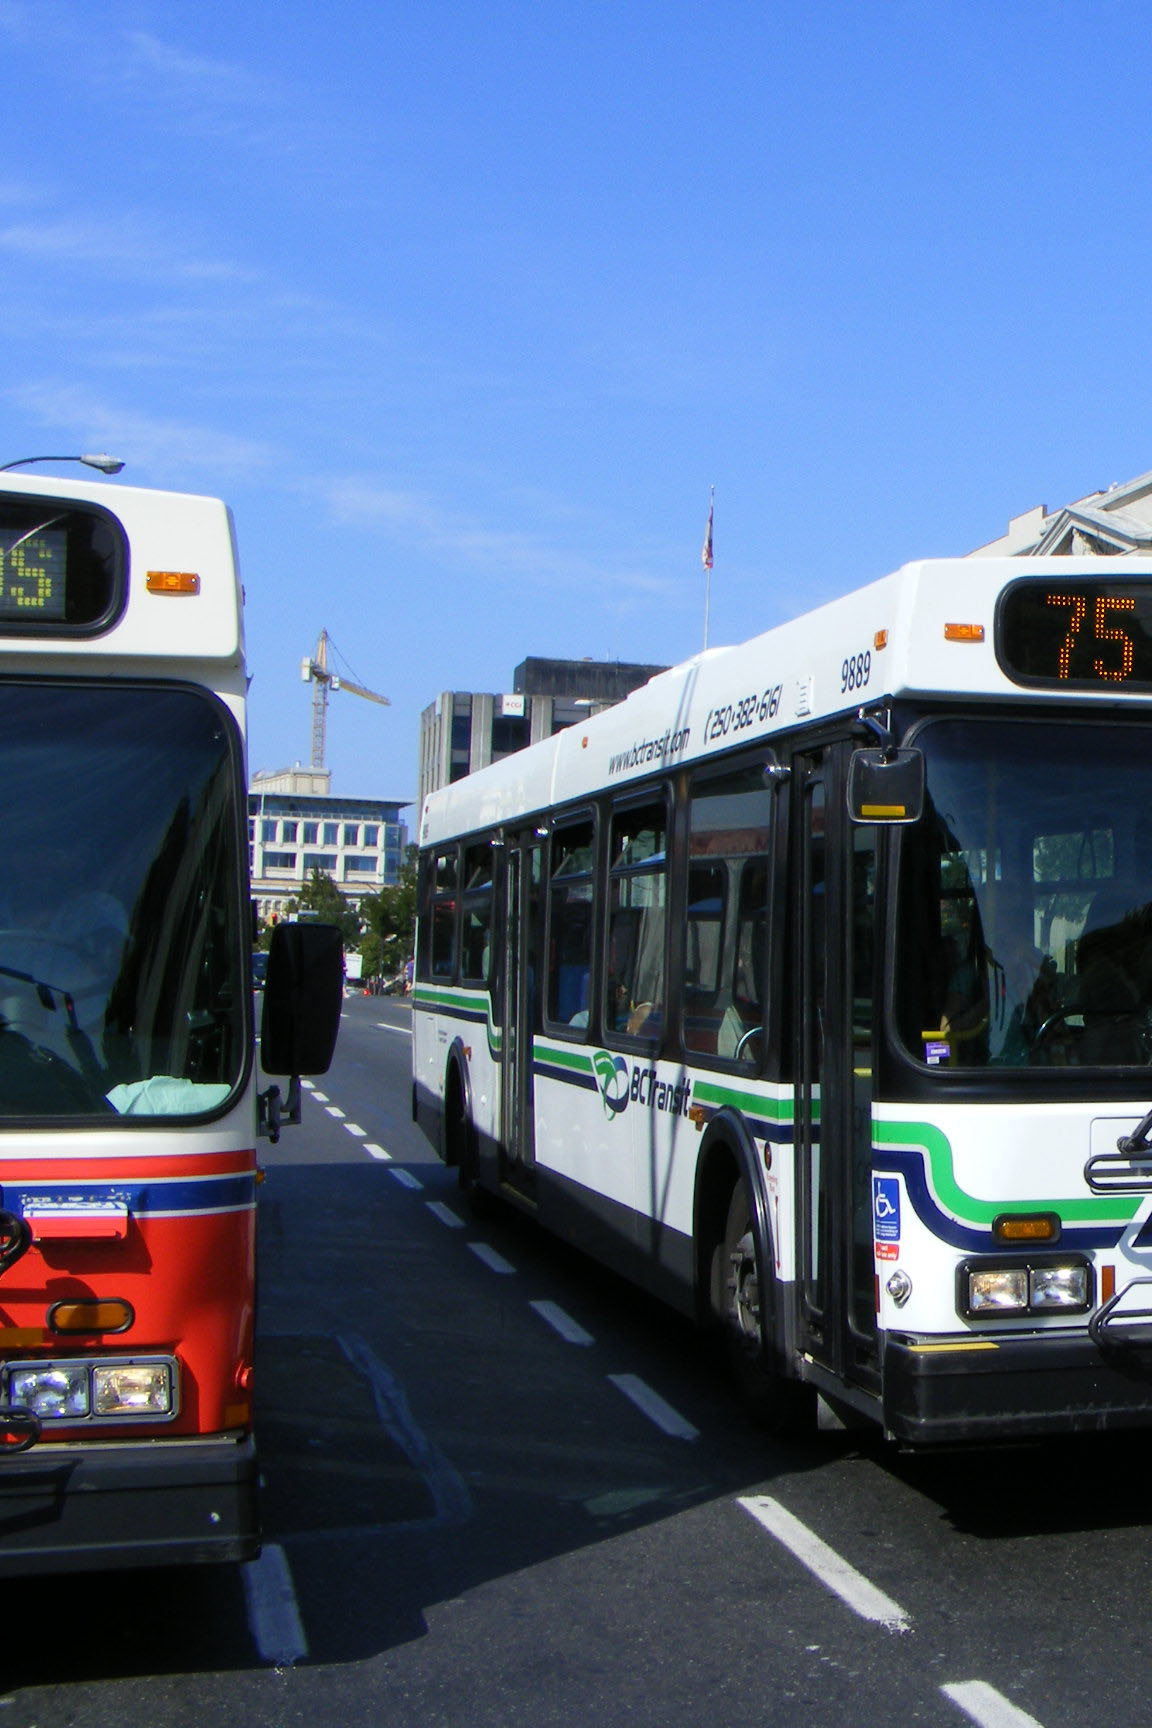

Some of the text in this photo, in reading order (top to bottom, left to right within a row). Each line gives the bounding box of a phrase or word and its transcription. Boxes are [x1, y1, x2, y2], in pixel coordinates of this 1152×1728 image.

[1046, 594, 1136, 683] 75
[840, 650, 871, 694] 9889
[608, 727, 691, 776] www.bctransit.com
